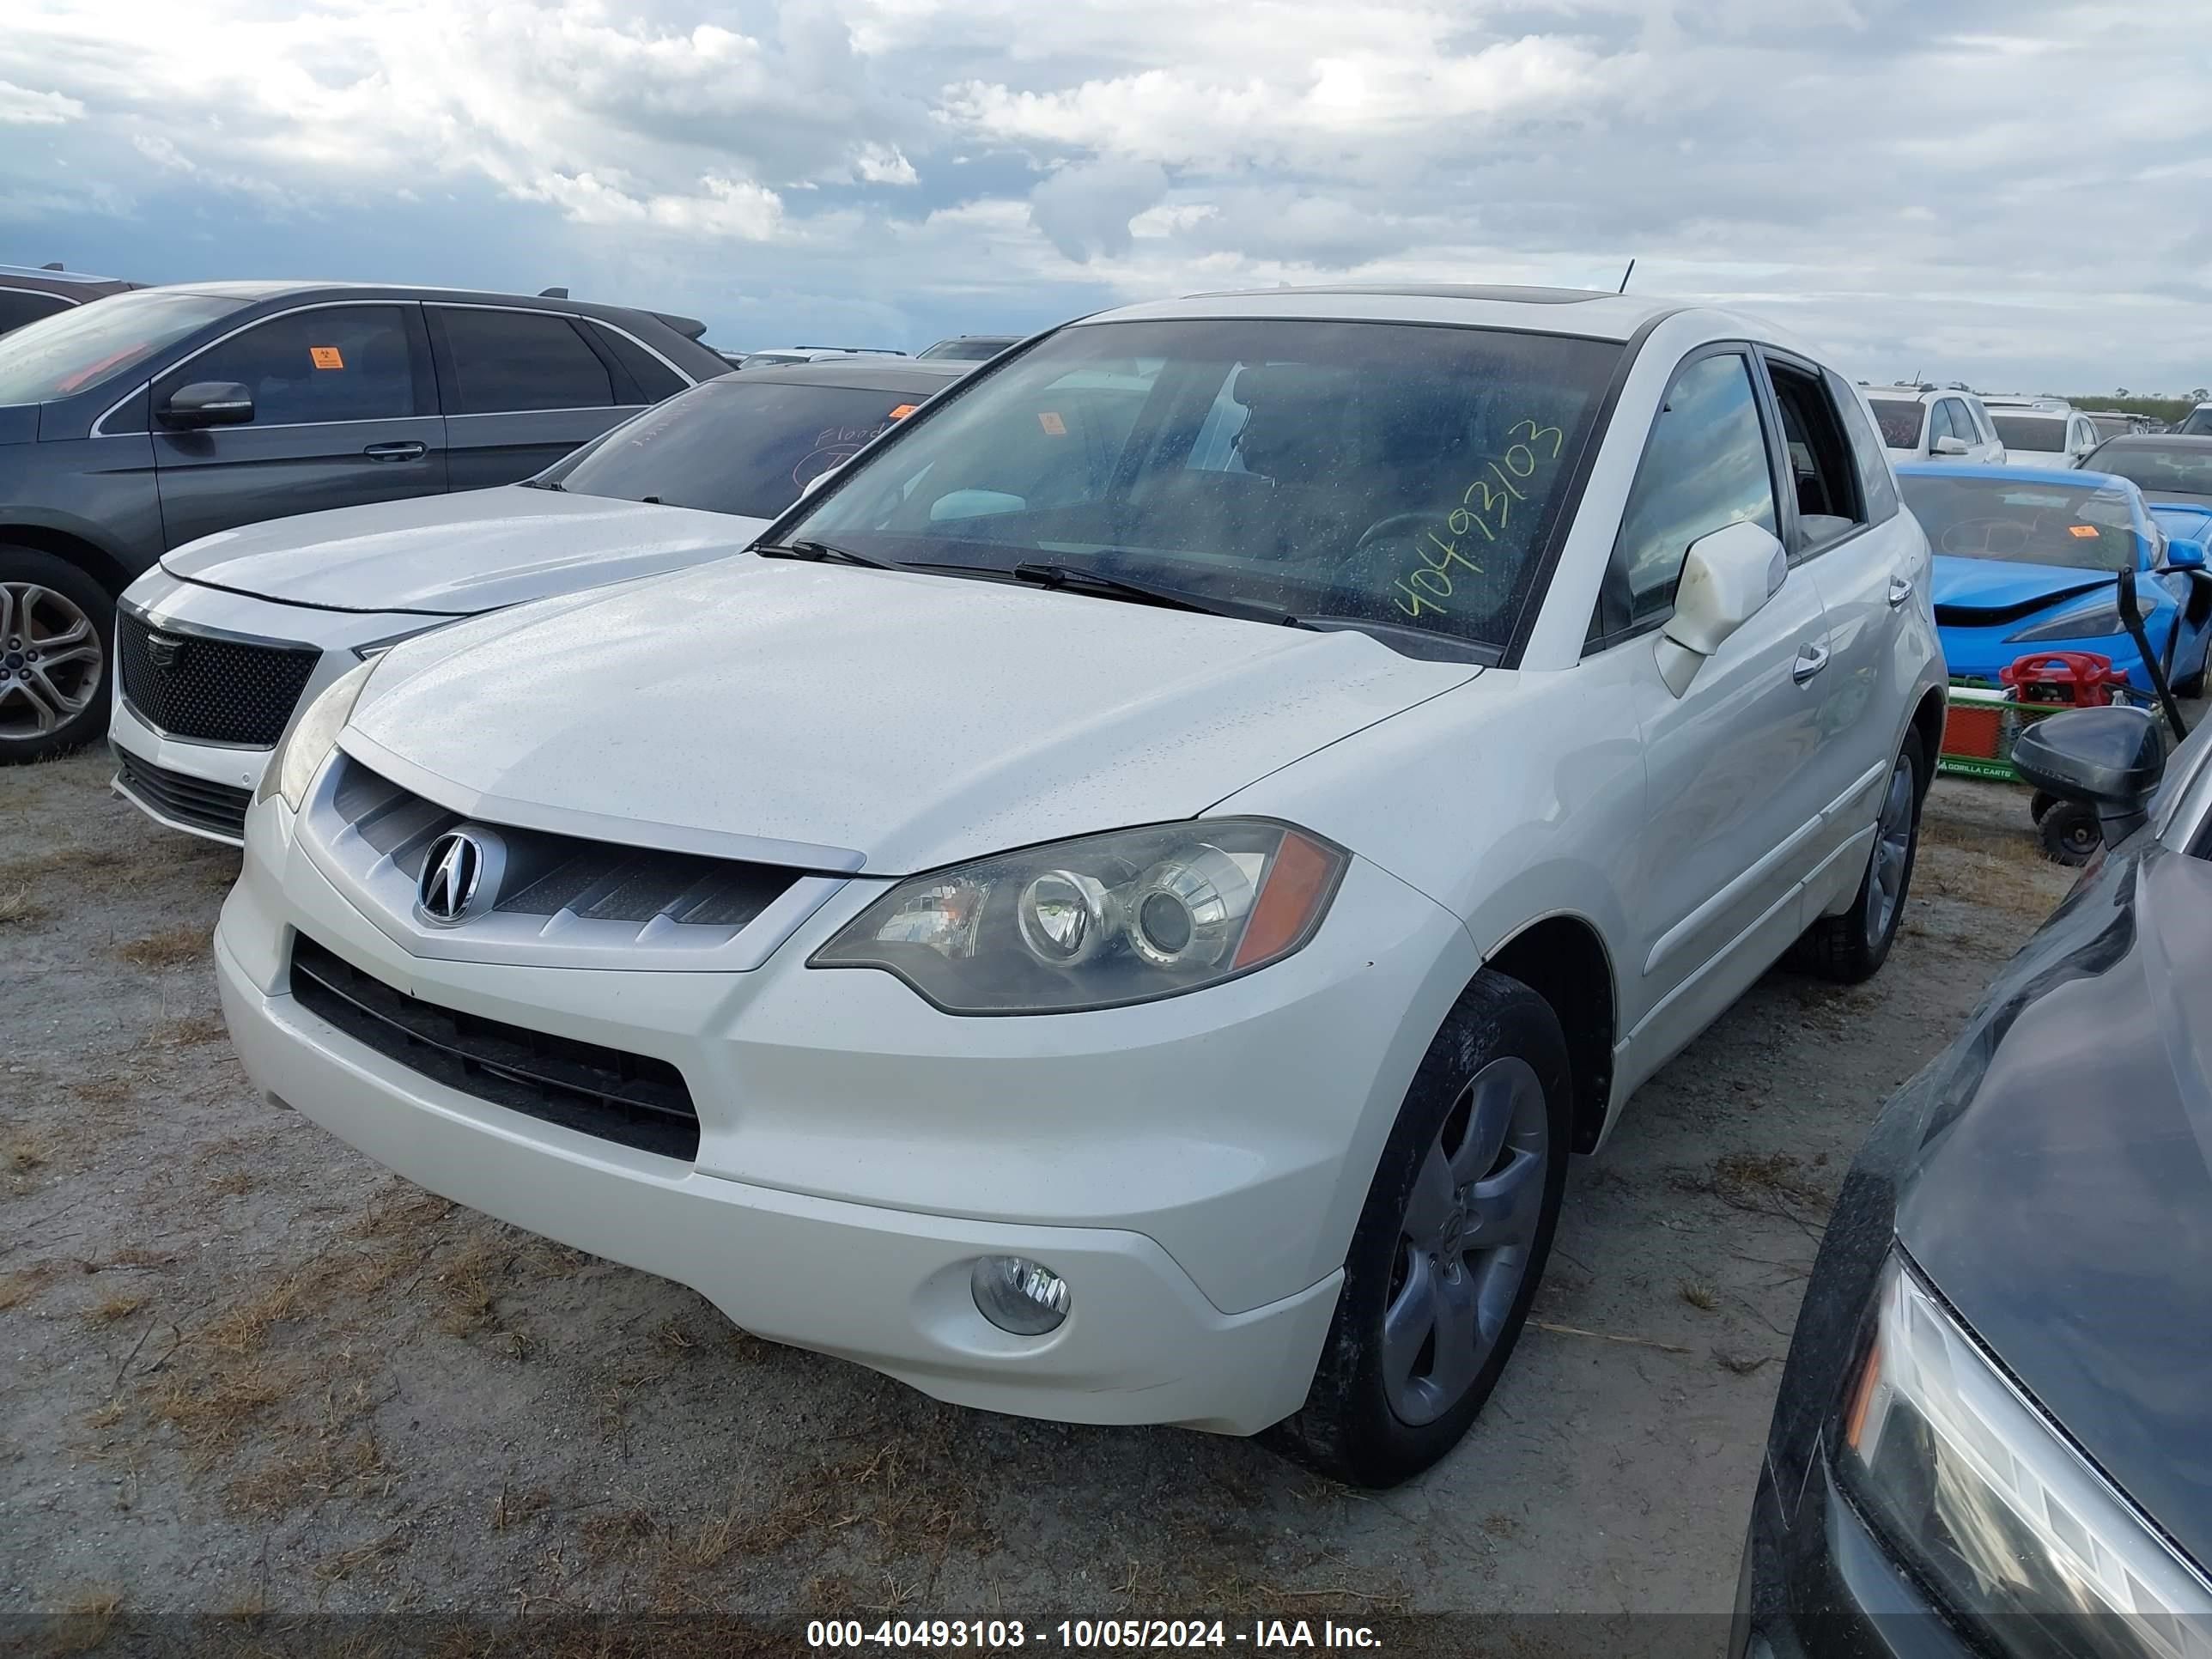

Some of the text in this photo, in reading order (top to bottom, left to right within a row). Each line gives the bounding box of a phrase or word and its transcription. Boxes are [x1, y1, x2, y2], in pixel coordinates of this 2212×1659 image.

[815, 422, 886, 447] Flood
[1394, 419, 1563, 617] 40493103
[1948, 763, 2011, 778] GORILLA CARTS
